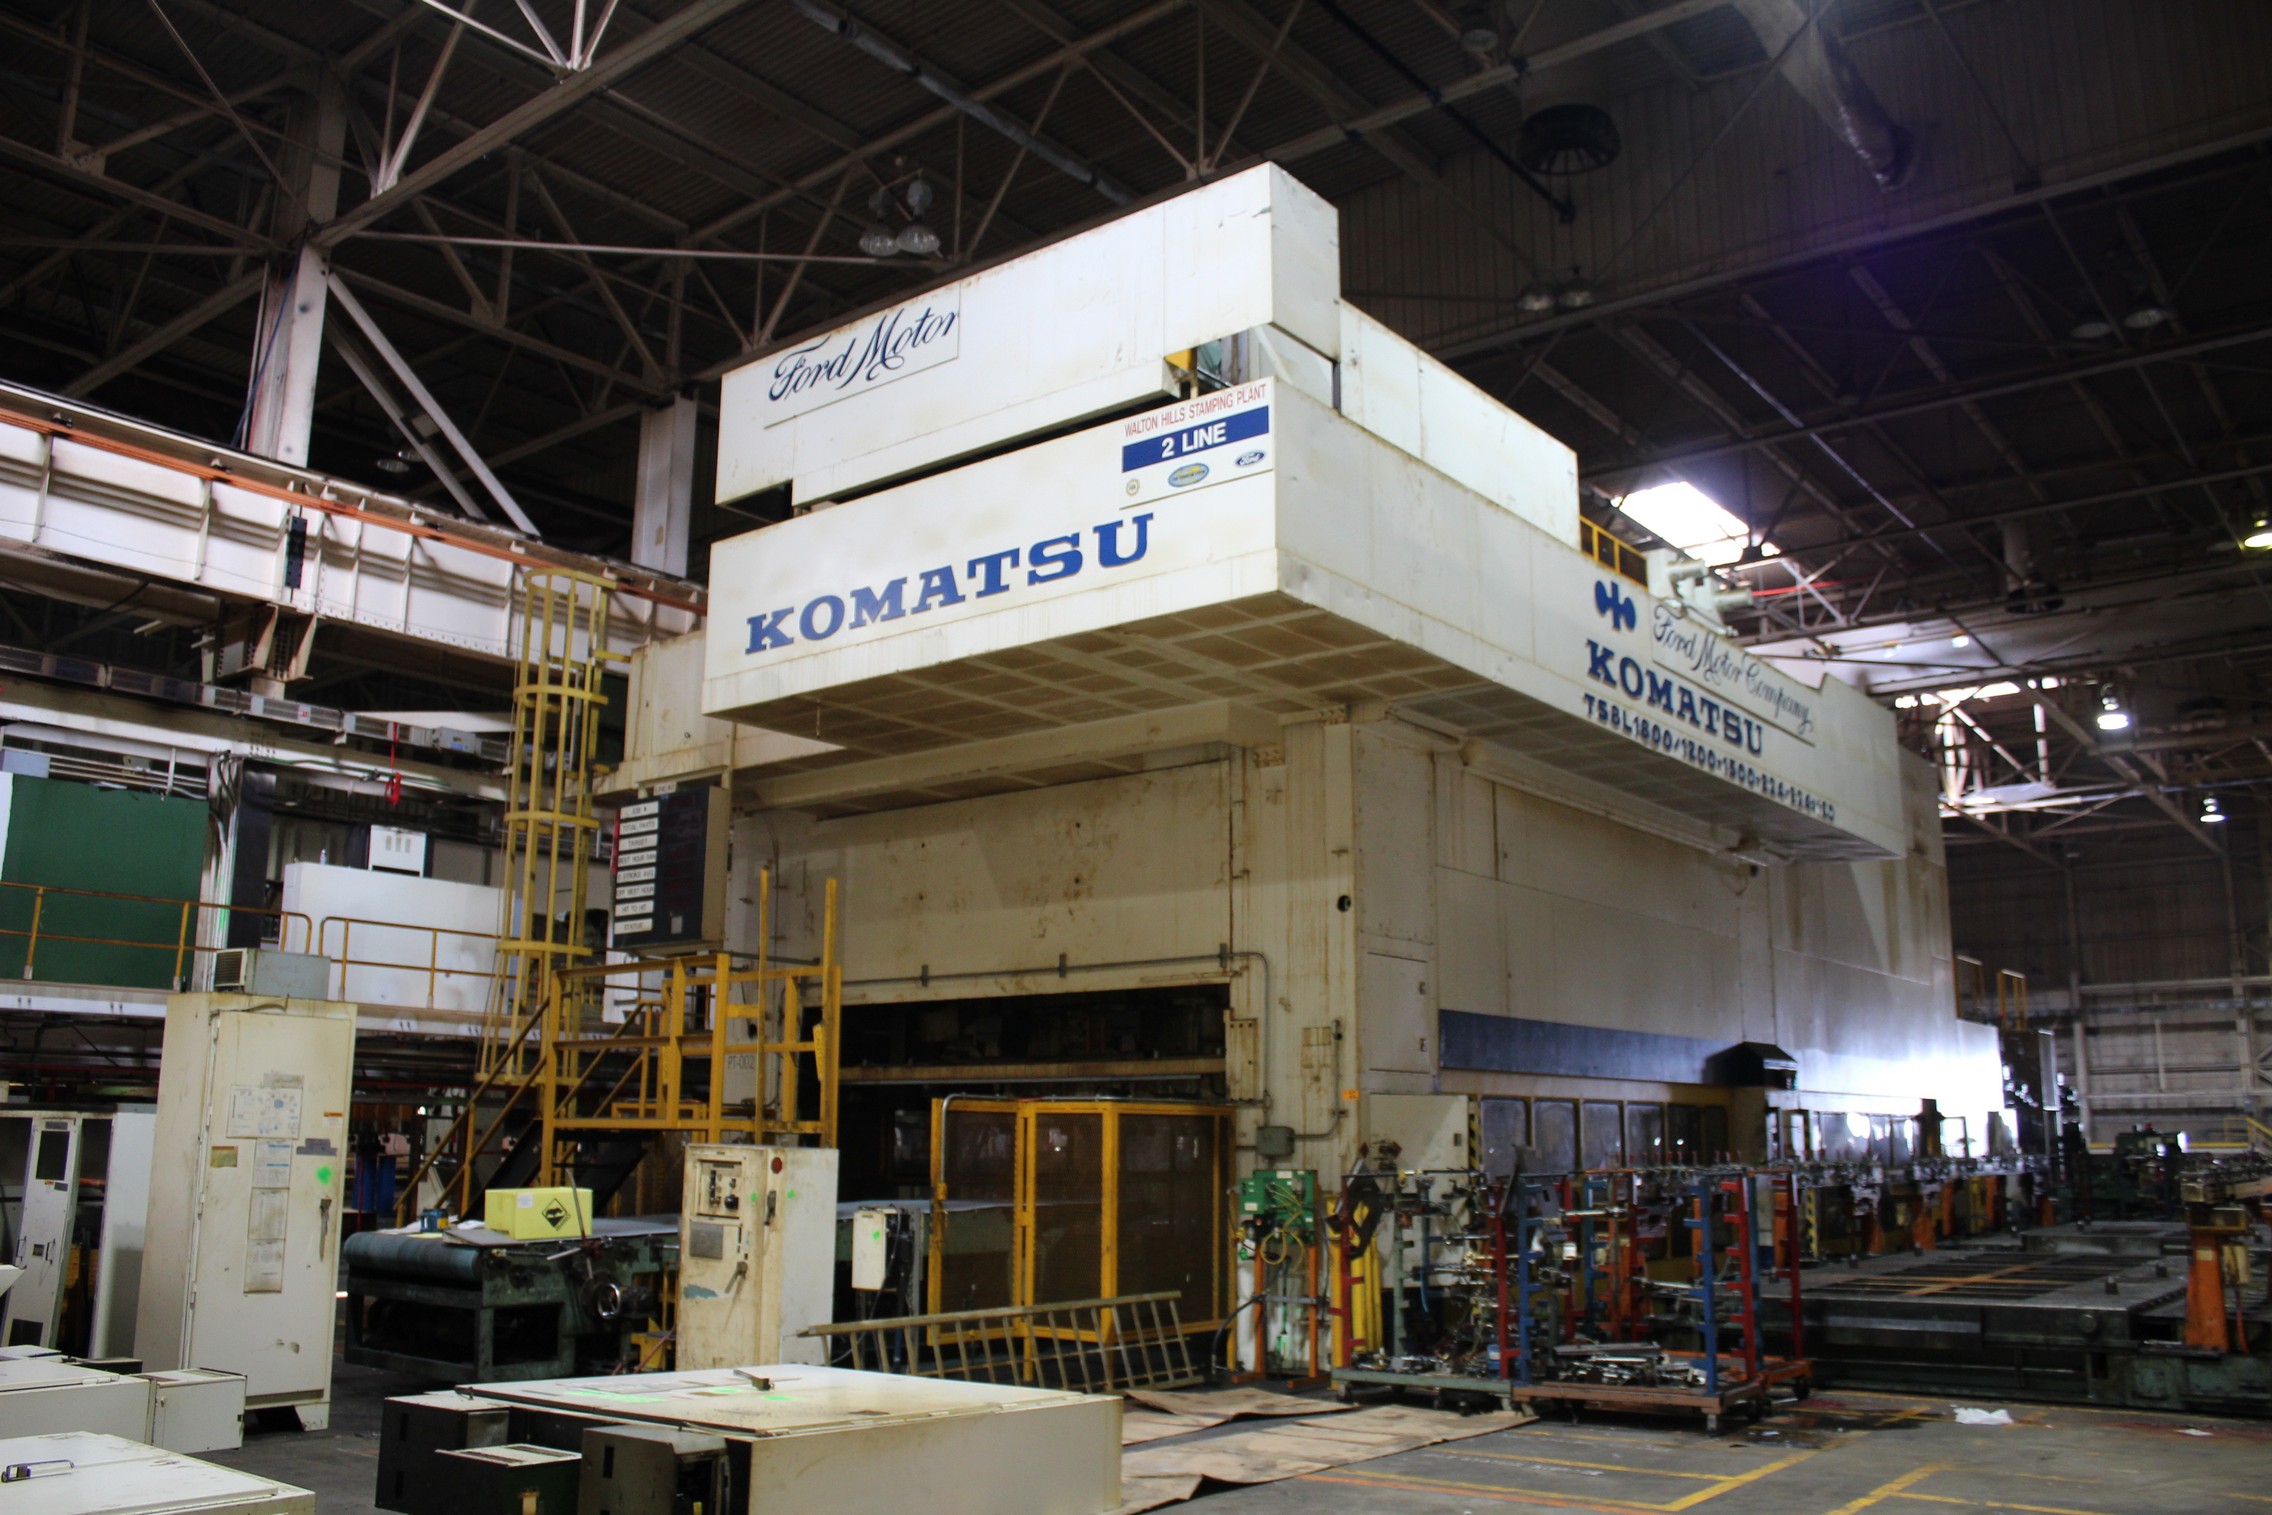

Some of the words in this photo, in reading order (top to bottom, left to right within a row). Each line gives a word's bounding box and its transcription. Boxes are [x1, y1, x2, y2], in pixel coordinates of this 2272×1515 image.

[769, 334, 857, 401] Ford
[835, 307, 959, 390] Motor
[1125, 416, 1158, 437] WALTON
[1161, 407, 1185, 426] HILLS
[1189, 393, 1233, 418] STAMPING
[1237, 383, 1266, 405] PLANT
[1161, 437, 1175, 458] 2
[1182, 421, 1227, 452] LINE
[746, 513, 1154, 655] KOMATSU
[1586, 639, 1763, 756] KOMATSU
[1654, 605, 1697, 661] Ford
[1692, 630, 1742, 686] Motor
[1743, 653, 1814, 735] Company
